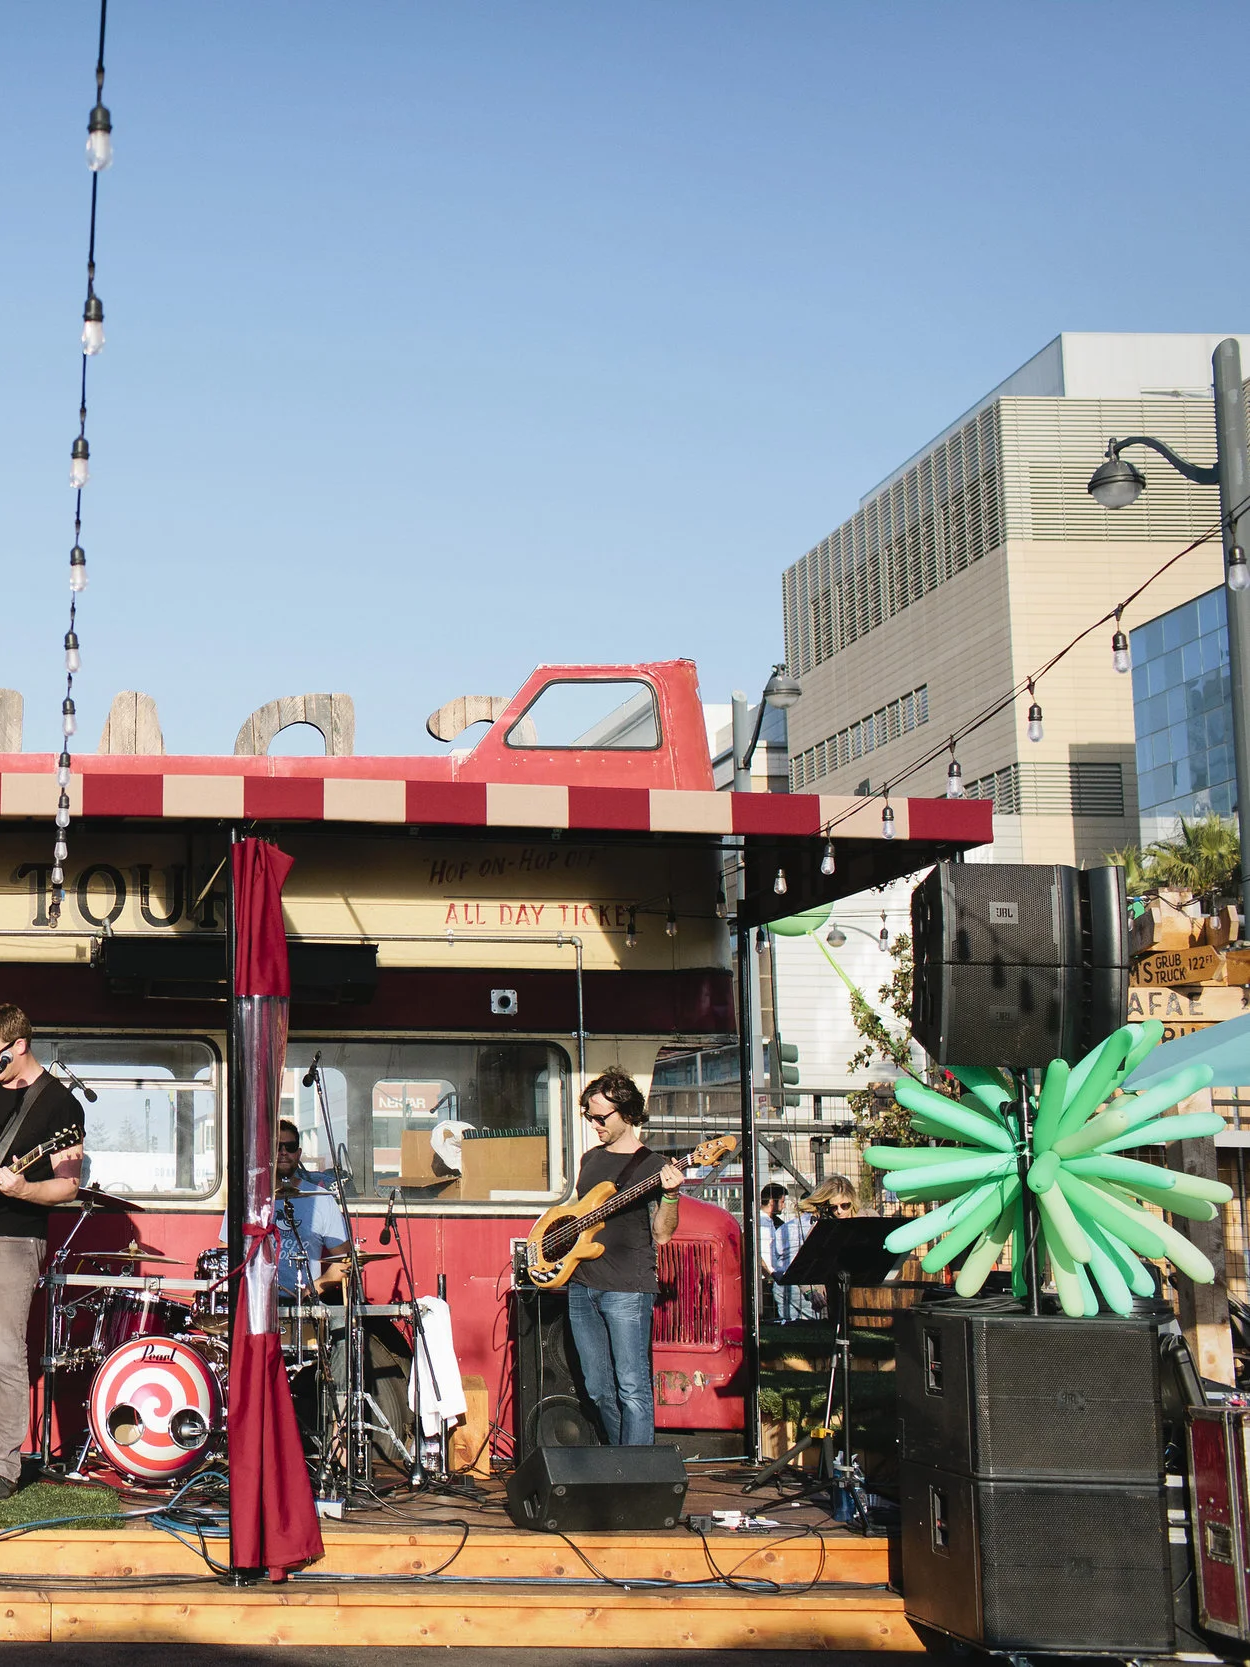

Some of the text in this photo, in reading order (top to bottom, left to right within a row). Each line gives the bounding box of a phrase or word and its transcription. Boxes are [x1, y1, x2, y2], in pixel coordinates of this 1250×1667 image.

[445, 903, 627, 927] ALL DAY TICKE
[996, 907, 1013, 918] JBL
[1155, 953, 1182, 969] GRUB
[1155, 967, 1186, 984] TRUCK
